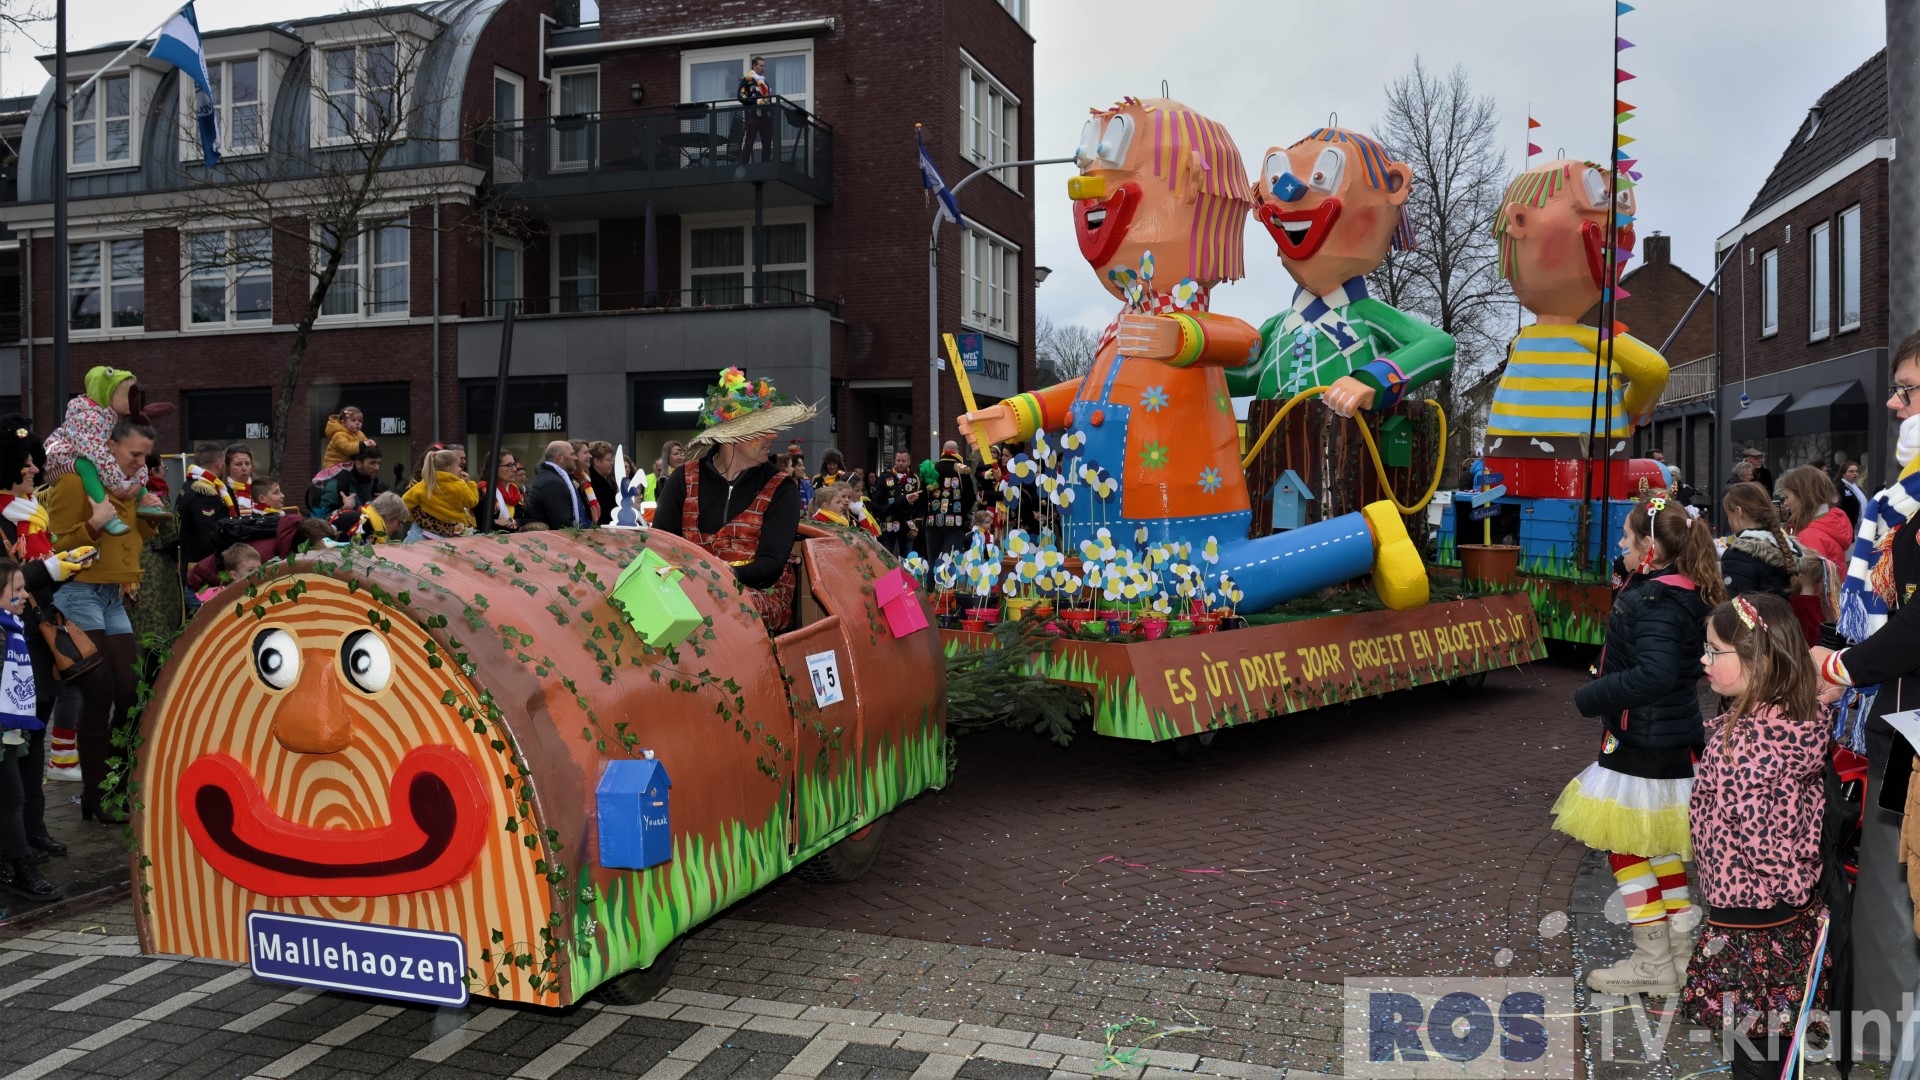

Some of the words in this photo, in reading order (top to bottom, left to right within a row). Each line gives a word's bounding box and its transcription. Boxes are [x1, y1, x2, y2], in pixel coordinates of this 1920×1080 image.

[826, 666, 836, 688] 5
[1164, 667, 1197, 705] ES
[1201, 651, 1233, 697] ÙT
[1240, 651, 1293, 692] DRIE
[1297, 643, 1346, 682] JOAR
[1349, 634, 1406, 671] GROEIT
[1409, 629, 1434, 660] EN
[1488, 618, 1508, 644] IS
[1506, 608, 1527, 639] ÙT
[257, 931, 456, 985] Mallehaozen
